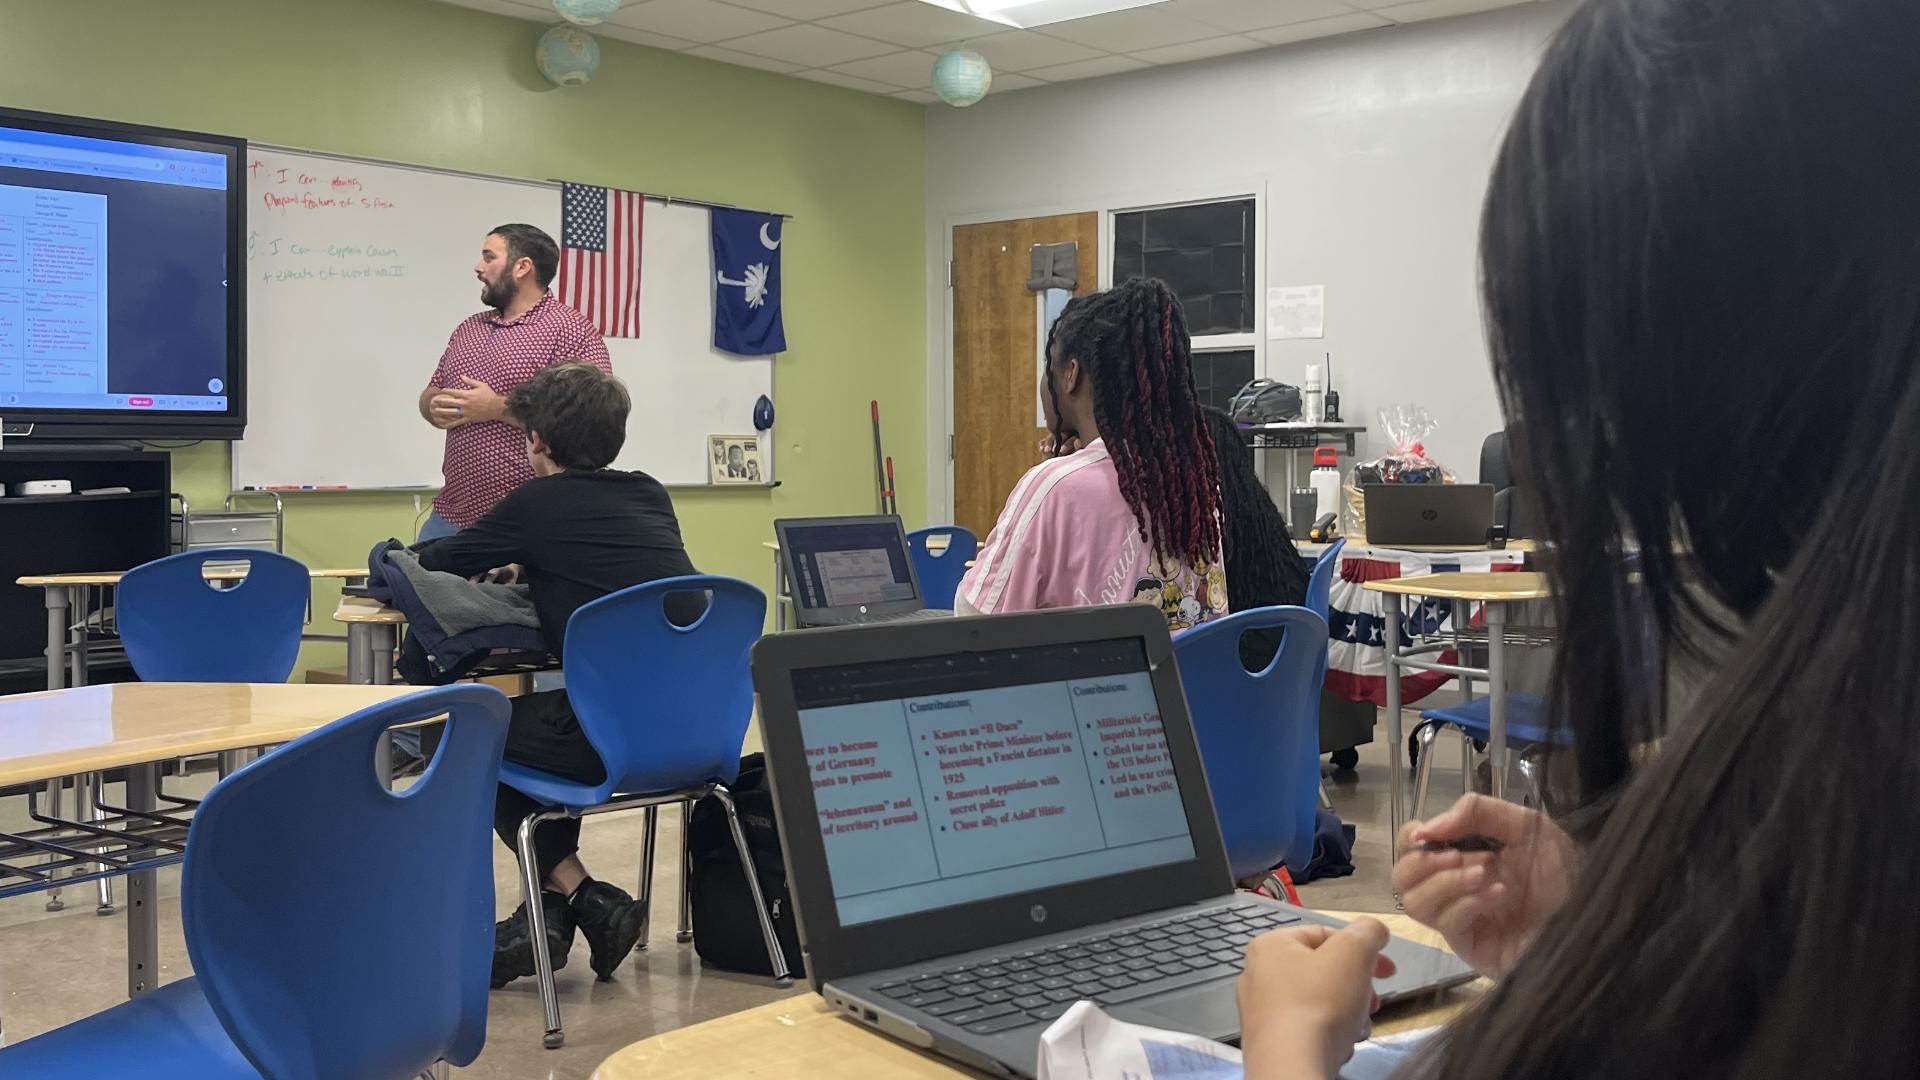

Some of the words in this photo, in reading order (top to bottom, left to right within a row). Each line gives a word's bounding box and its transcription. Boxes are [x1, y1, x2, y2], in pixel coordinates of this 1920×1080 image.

[933, 726, 967, 740] Known
[969, 727, 980, 736] as
[1100, 728, 1136, 743] Imperial
[828, 745, 839, 754] to
[840, 739, 879, 753] become
[936, 744, 958, 755] Was
[960, 742, 975, 752] the
[976, 739, 1004, 751] Prime
[1006, 734, 1043, 747] Minister
[1046, 730, 1073, 742] before
[1103, 743, 1131, 756] Called
[1132, 742, 1144, 752] for
[815, 761, 826, 772] of
[828, 755, 876, 770] Germany
[939, 755, 985, 770] becoming
[994, 749, 1025, 763] Fascist
[1026, 745, 1060, 758] dictator
[1062, 743, 1072, 753] in
[1106, 759, 1121, 769] the
[1122, 756, 1135, 767] US
[1136, 753, 1162, 766] before
[838, 775, 849, 785] to
[851, 768, 893, 785] promote
[943, 772, 965, 785] 1925
[1110, 774, 1126, 785] Led
[1128, 772, 1138, 782] in
[1139, 771, 1154, 780] war
[946, 785, 990, 801] Removed
[991, 780, 1039, 795] opposition
[1040, 775, 1060, 786] with
[1114, 788, 1130, 799] and
[1131, 785, 1146, 796] the
[1146, 781, 1174, 793] Pacific
[893, 797, 912, 810] and
[949, 803, 977, 815] secret
[979, 798, 1006, 812] police
[823, 824, 834, 835] of
[836, 819, 880, 834] territory
[882, 811, 919, 826] around
[952, 819, 979, 832] Close
[981, 815, 998, 827] ally
[1000, 812, 1009, 823] of
[1011, 809, 1037, 821] Adolf
[1038, 804, 1065, 816] Hitler
